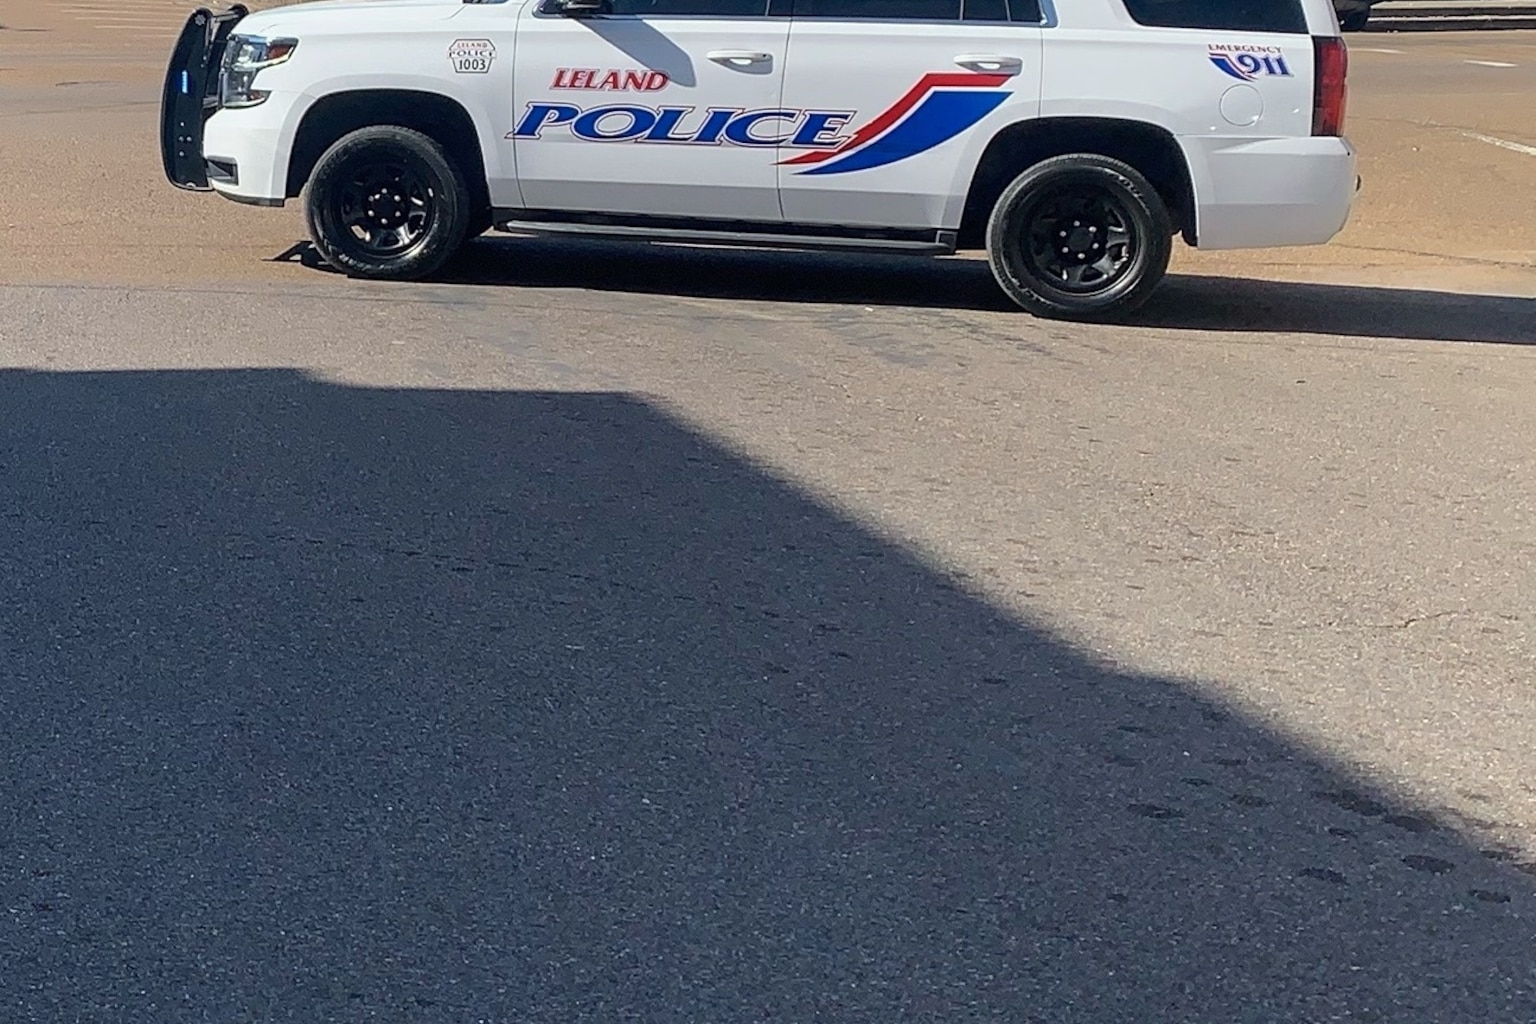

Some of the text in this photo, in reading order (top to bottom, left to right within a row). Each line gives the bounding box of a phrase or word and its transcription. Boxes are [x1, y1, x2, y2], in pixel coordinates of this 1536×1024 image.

[448, 50, 496, 58] POLICE
[1208, 44, 1282, 53] EMERGENCY
[458, 58, 486, 70] 1003
[1237, 54, 1293, 77] 911
[551, 67, 670, 92] LELAND
[505, 101, 857, 149] POLICE
